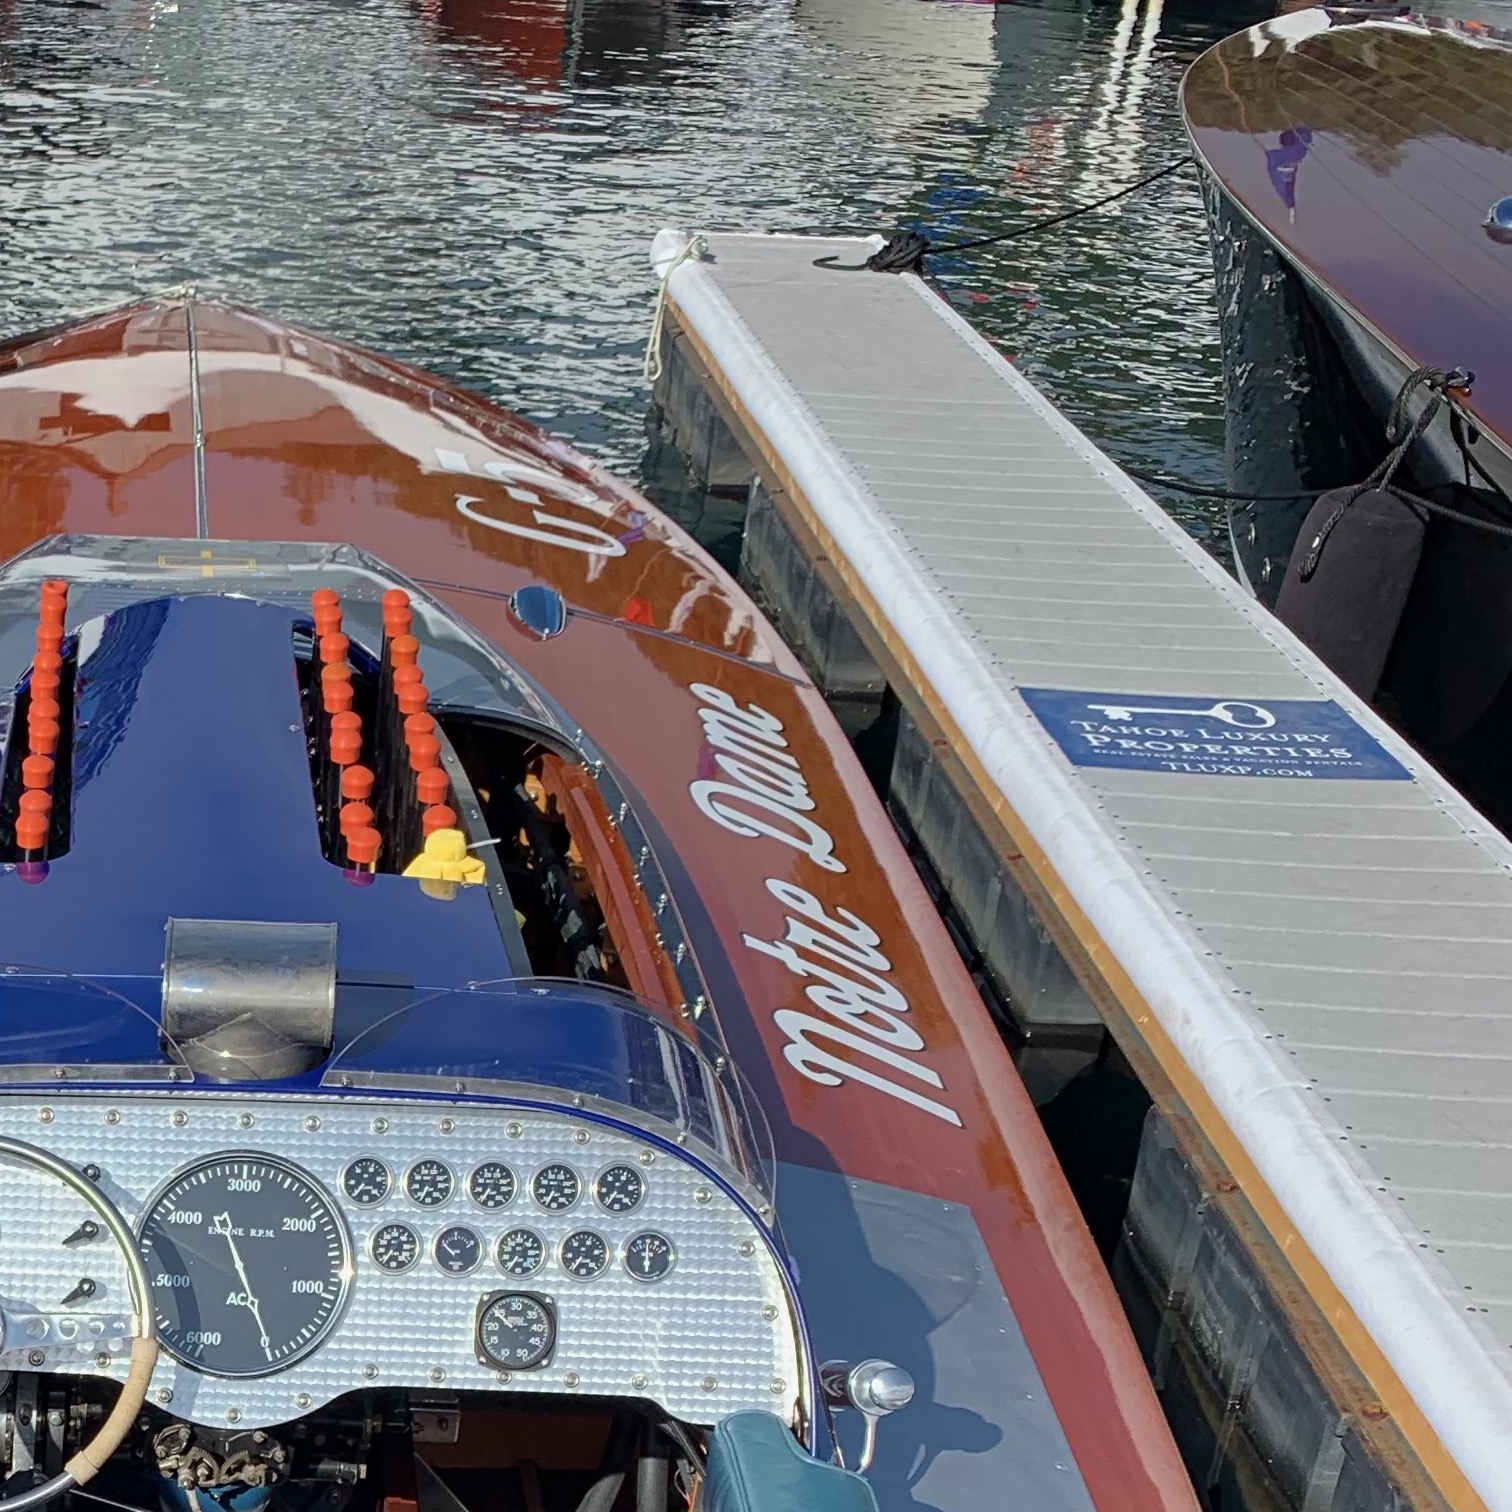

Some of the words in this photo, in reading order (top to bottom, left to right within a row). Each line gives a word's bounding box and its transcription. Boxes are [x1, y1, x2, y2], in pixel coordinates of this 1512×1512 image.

[1070, 720, 1189, 737] TAHOE
[1195, 728, 1331, 743] LUXURY
[1080, 733, 1352, 759] PROPERTIES
[688, 683, 848, 874] Dame
[741, 878, 966, 1128] Notre
[227, 1178, 261, 1192] 3000
[167, 1210, 203, 1225] 4000
[281, 1217, 317, 1232] 2000
[249, 1227, 276, 1238] R.P.M.
[155, 1273, 191, 1288] 5000
[291, 1279, 324, 1294] 1000
[225, 1291, 249, 1306] AC
[510, 1302, 523, 1311] 30
[526, 1310, 538, 1320] 35
[487, 1322, 499, 1331] 20
[531, 1323, 543, 1333] 40
[185, 1331, 221, 1346] 6000
[490, 1335, 499, 1344] 15
[529, 1336, 541, 1346] 45
[501, 1348, 510, 1357] 10
[516, 1348, 528, 1358] 50
